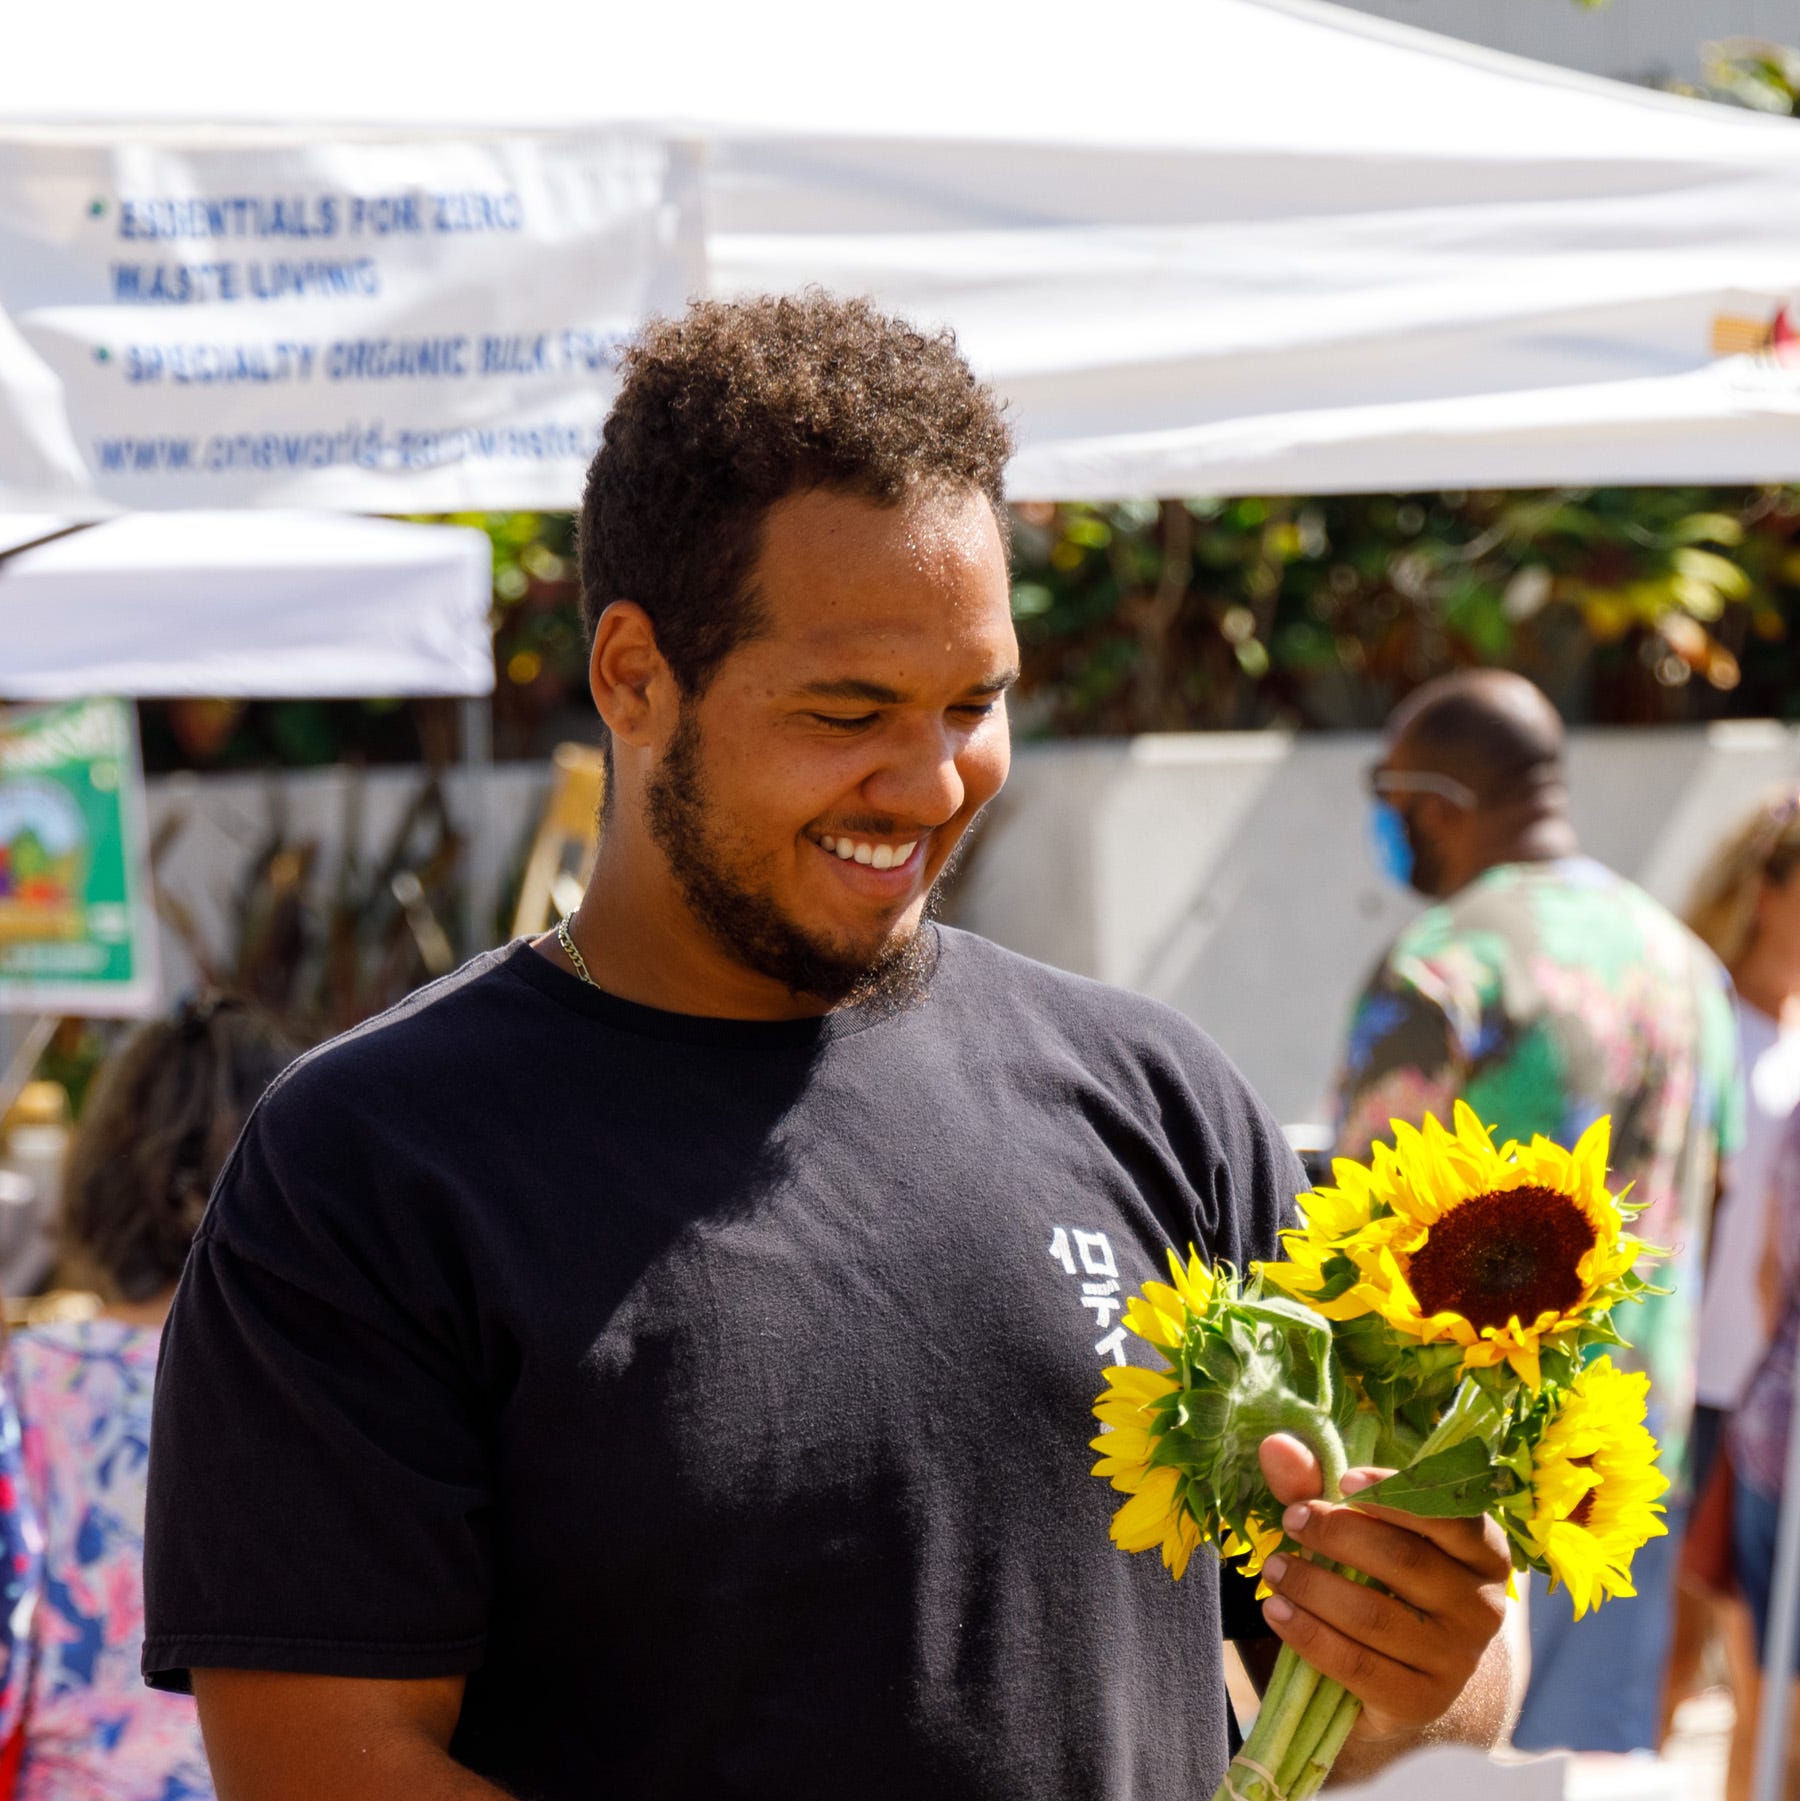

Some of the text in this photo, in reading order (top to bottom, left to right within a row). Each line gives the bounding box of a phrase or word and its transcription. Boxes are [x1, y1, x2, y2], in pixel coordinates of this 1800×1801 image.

[118, 196, 339, 240] ESSENTIALS
[349, 194, 421, 235] FOR
[111, 256, 380, 301] WASTE LIVING
[124, 345, 316, 384] SPECIALTY
[325, 336, 468, 380] ORGANIC
